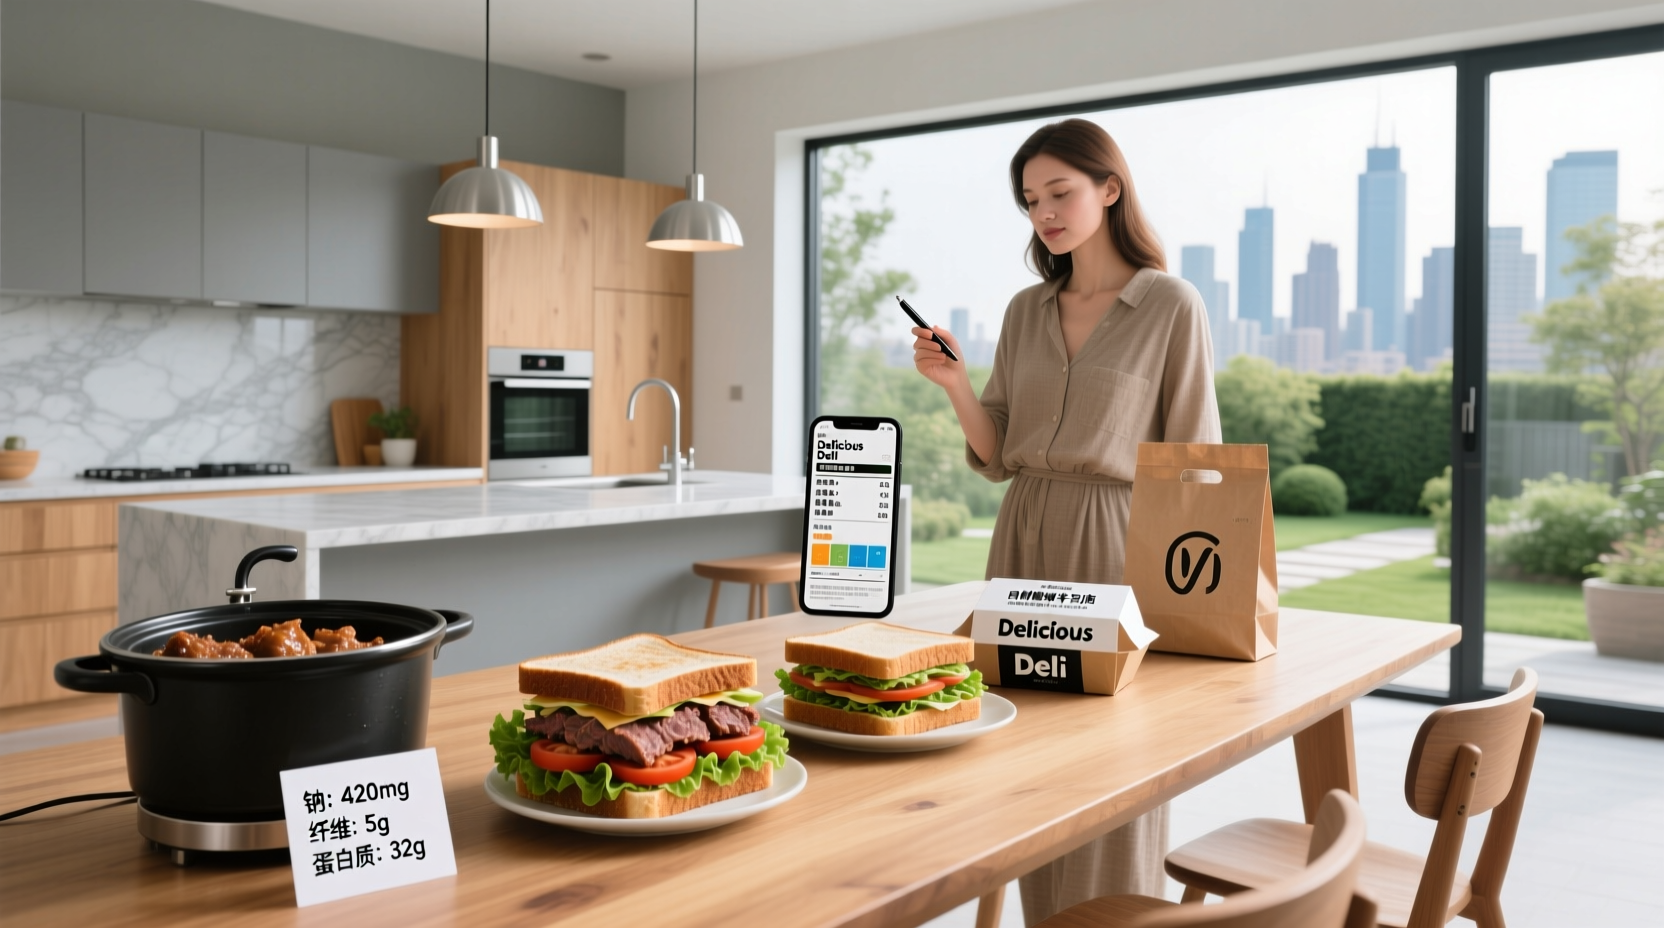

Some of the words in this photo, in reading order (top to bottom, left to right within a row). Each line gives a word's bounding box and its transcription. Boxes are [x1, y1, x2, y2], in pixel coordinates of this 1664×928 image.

[998, 618, 1093, 642] Delicious
[1014, 653, 1067, 678] Deli
[341, 781, 409, 804] 420mg
[365, 813, 390, 836] 5g
[389, 838, 426, 860] 32g
